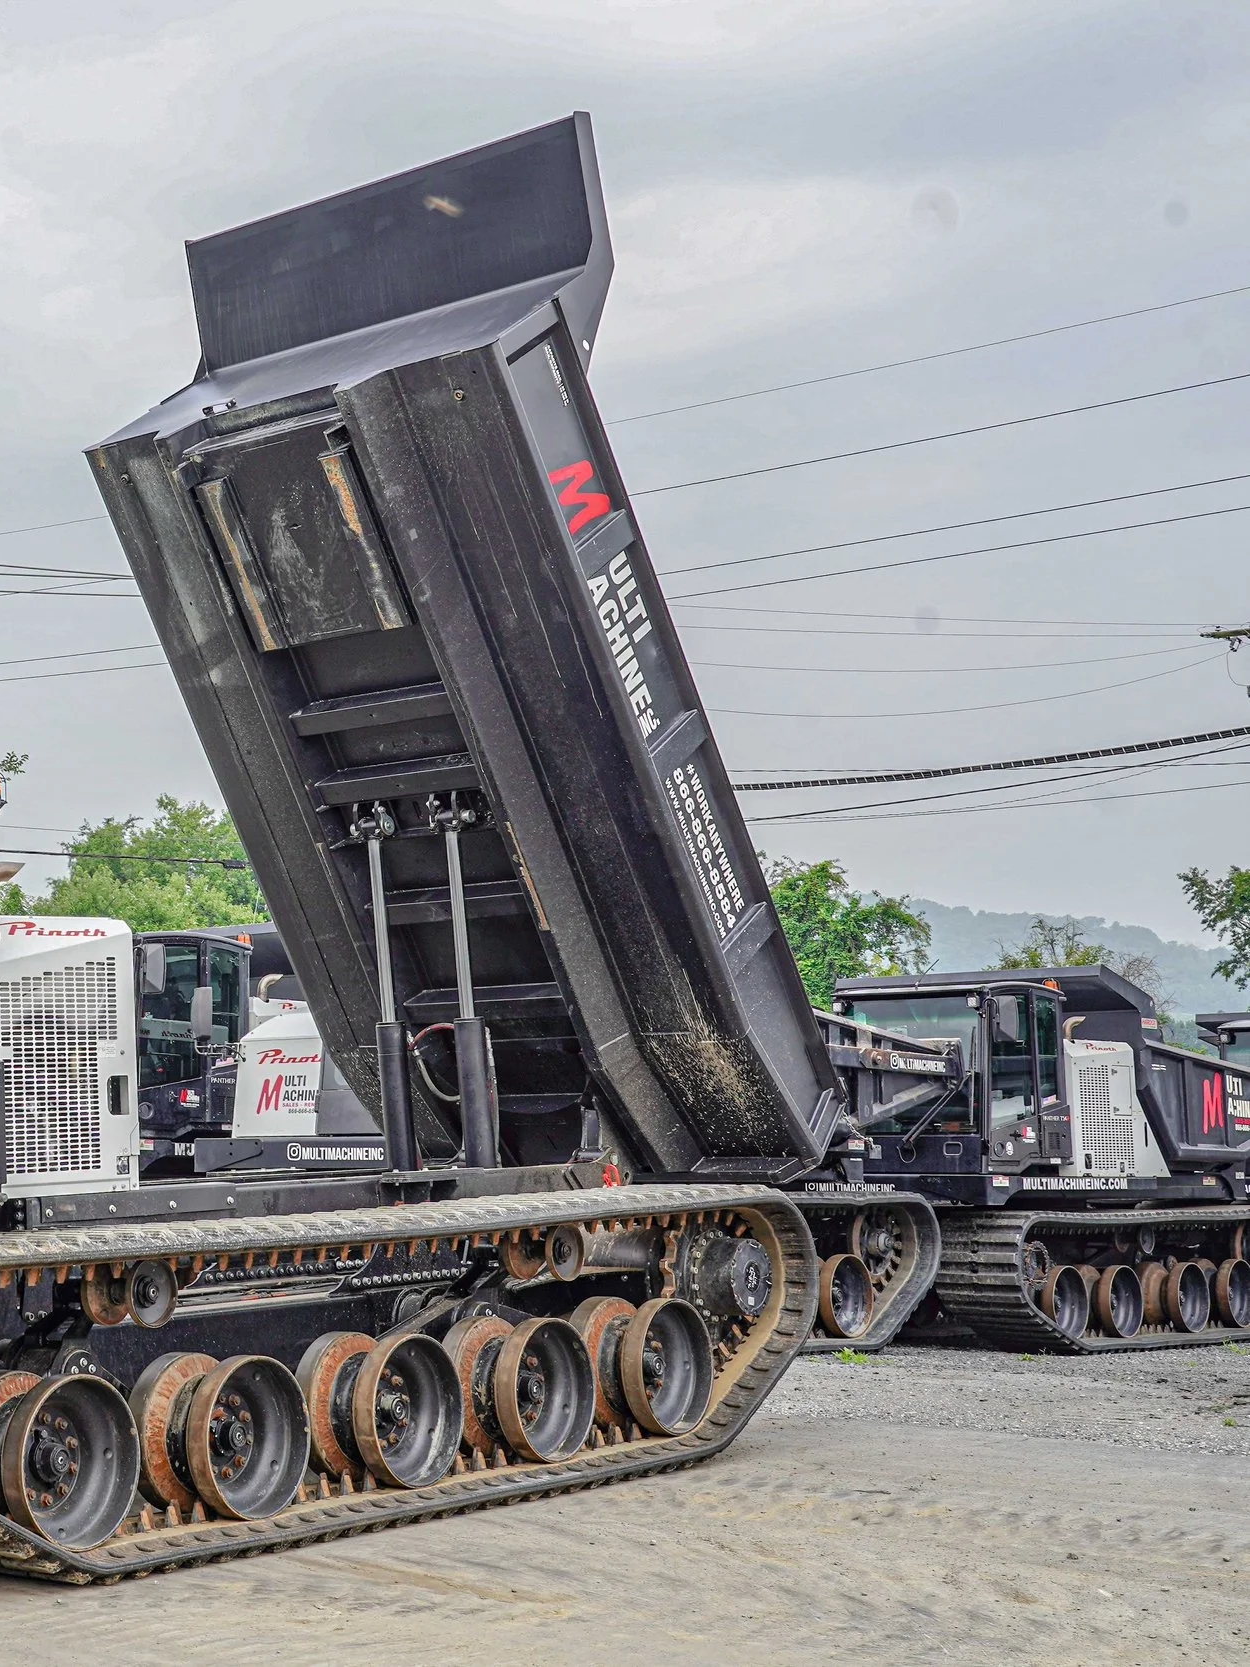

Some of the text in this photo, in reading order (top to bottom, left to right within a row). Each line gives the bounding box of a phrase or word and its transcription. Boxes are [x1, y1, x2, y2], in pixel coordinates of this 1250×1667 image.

[664, 778, 726, 938] WWW.MULTIMACHINEINC.COM
[672, 767, 737, 928] 866-866-8584
[686, 763, 745, 912] #WORKANYWHERE
[0, 921, 107, 937] Prinoth
[301, 1147, 384, 1160] MULTIMACHINEINC
[1023, 1177, 1128, 1190] MULTIMACHINEINC.COM
